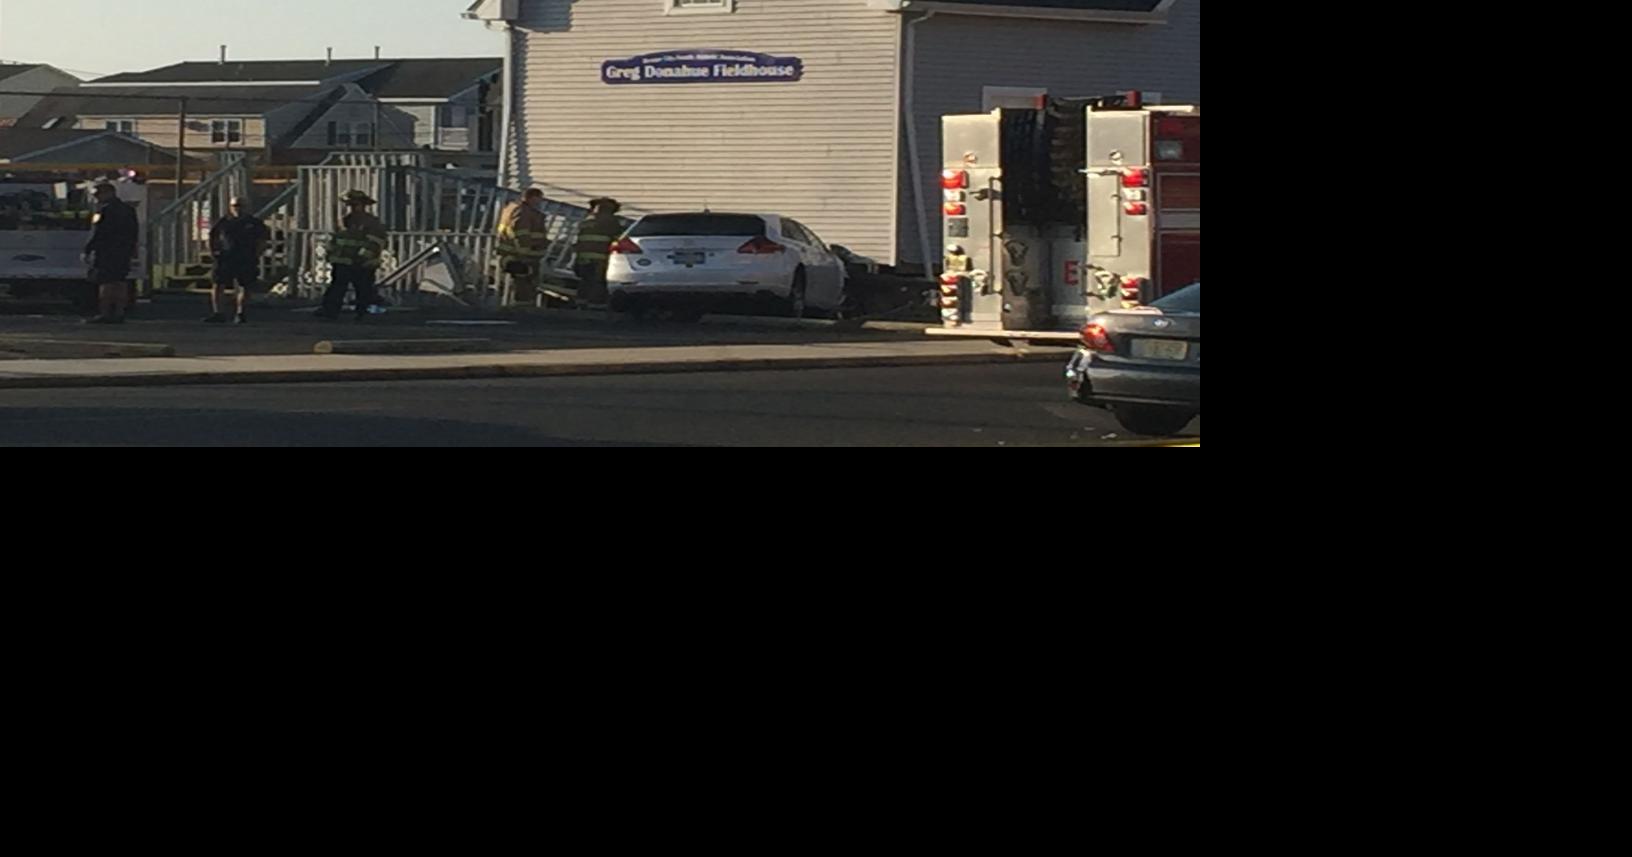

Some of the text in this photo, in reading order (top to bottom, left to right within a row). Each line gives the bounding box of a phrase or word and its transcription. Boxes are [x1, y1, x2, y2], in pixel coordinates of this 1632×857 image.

[606, 63, 794, 80] Greg Donahue Fieldhouse
